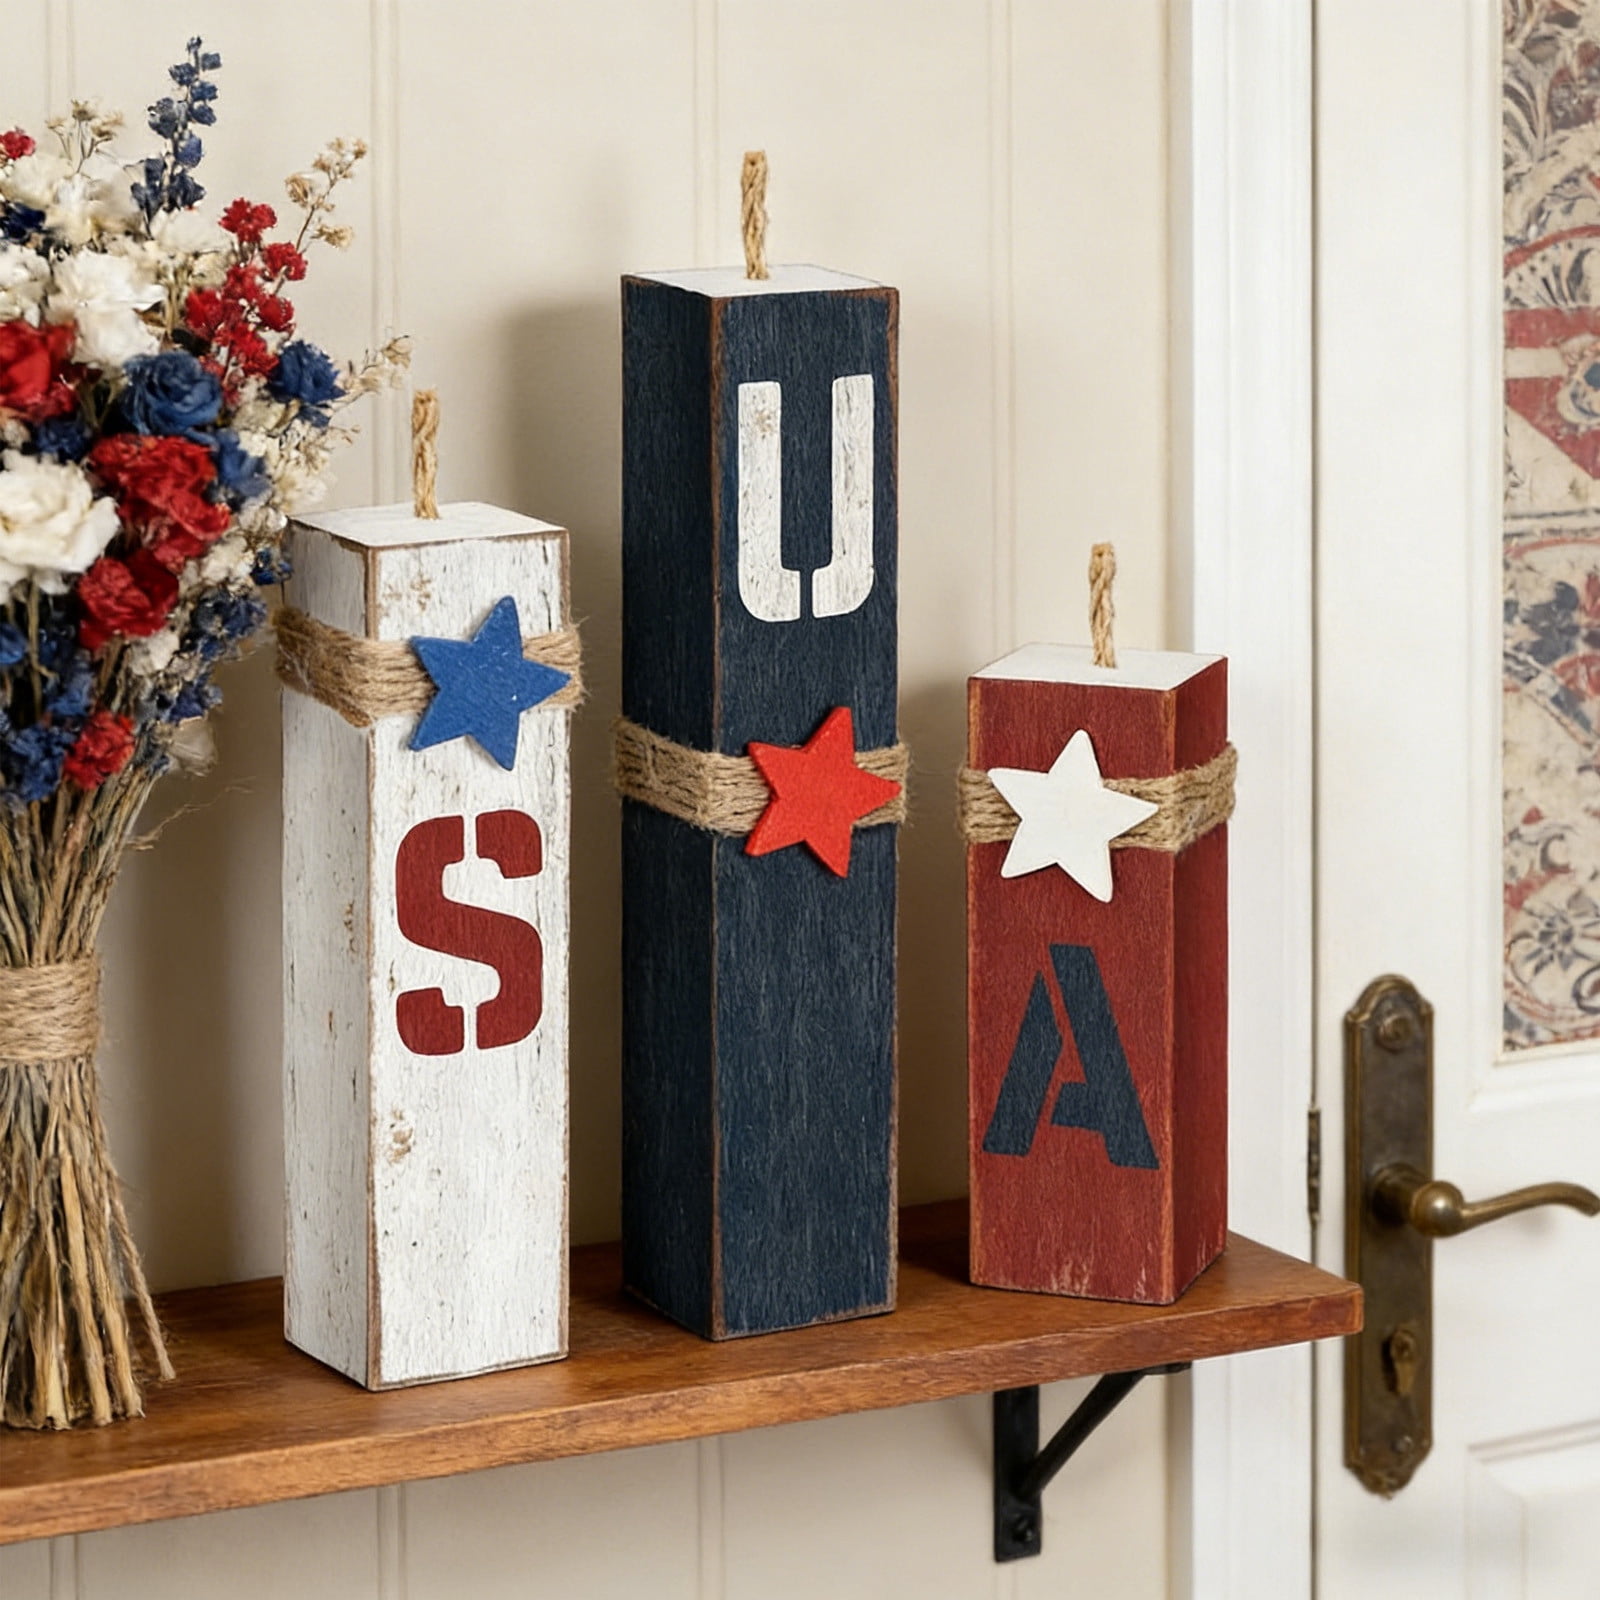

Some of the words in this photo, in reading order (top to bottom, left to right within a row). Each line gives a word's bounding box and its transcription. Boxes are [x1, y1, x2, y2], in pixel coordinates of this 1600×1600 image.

[736, 373, 876, 623] U
[395, 809, 543, 1056] S
[982, 943, 1160, 1170] A
